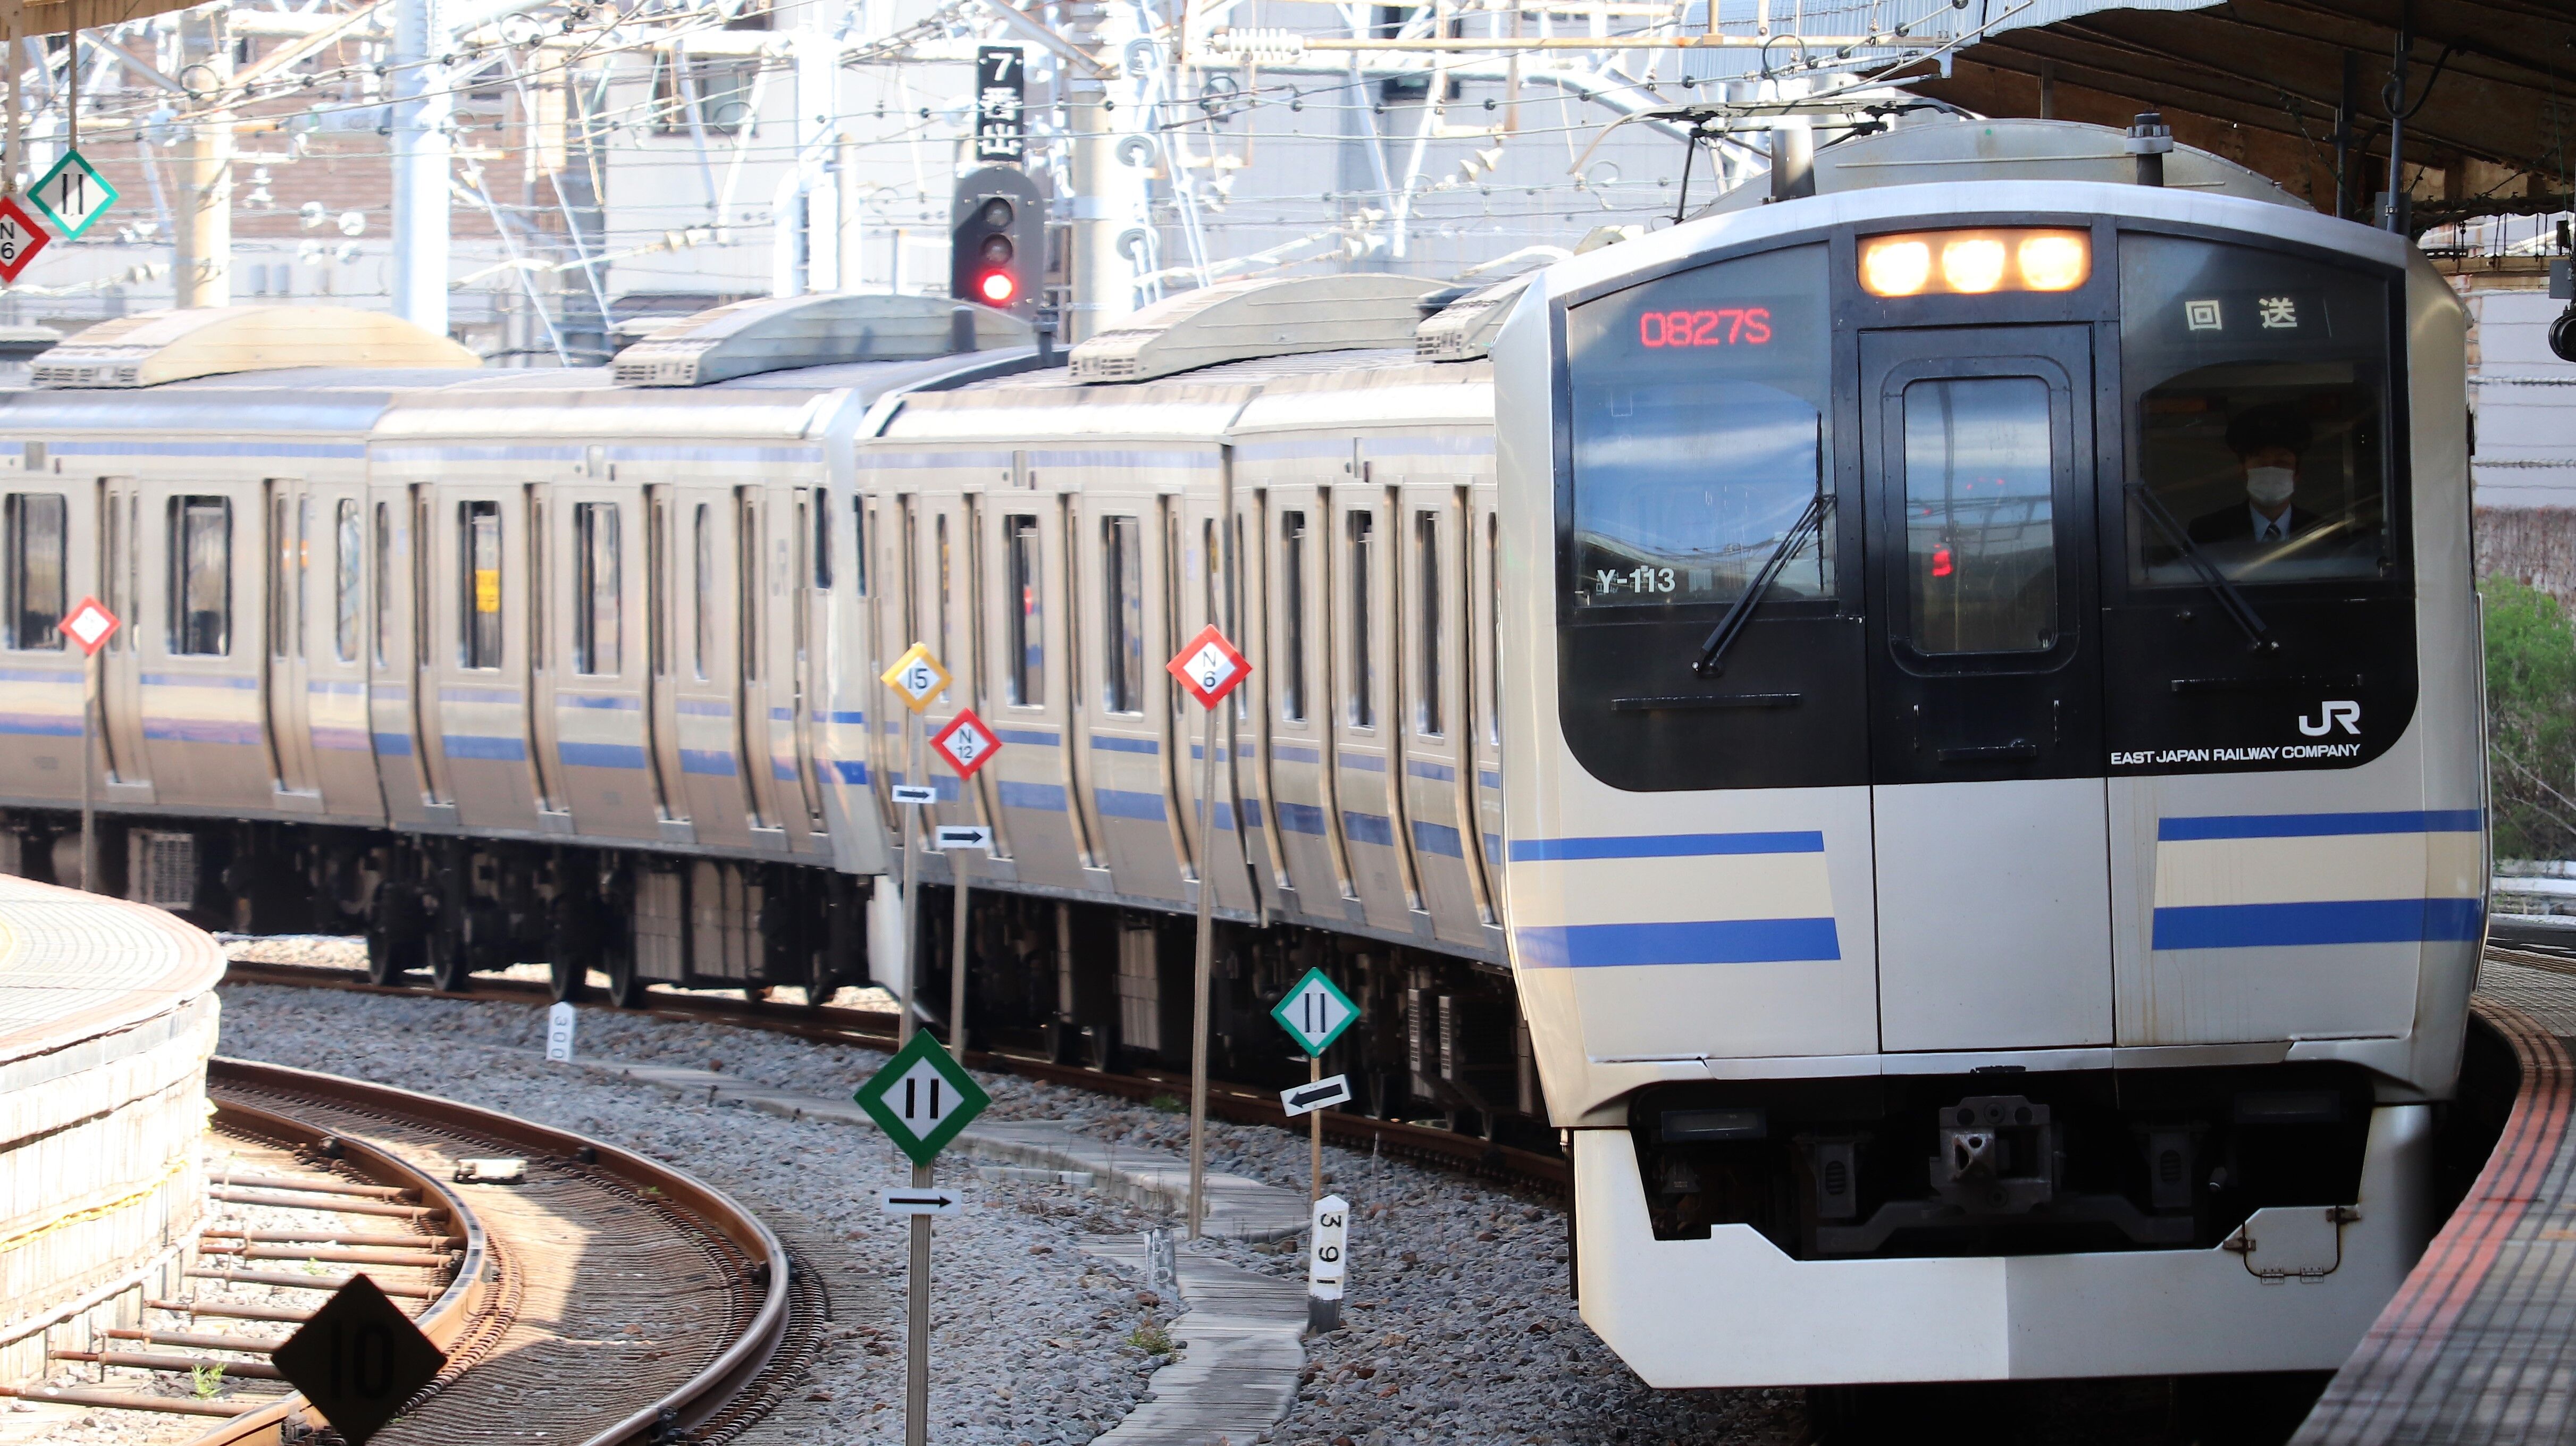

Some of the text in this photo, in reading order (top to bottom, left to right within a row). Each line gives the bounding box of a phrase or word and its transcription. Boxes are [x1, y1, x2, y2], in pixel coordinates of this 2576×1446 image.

[0, 222, 14, 239] N
[1, 242, 14, 259] 6
[2185, 297, 2297, 331] 回送
[1597, 568, 1675, 593] Y-113
[1203, 651, 1216, 667] N
[908, 668, 927, 689] 15
[1203, 671, 1216, 687] 6
[2298, 700, 2361, 736] JR
[958, 728, 971, 744] N
[956, 746, 972, 758] 12
[2111, 744, 2361, 765] EAST JAPAN RAILWAY COMPANY
